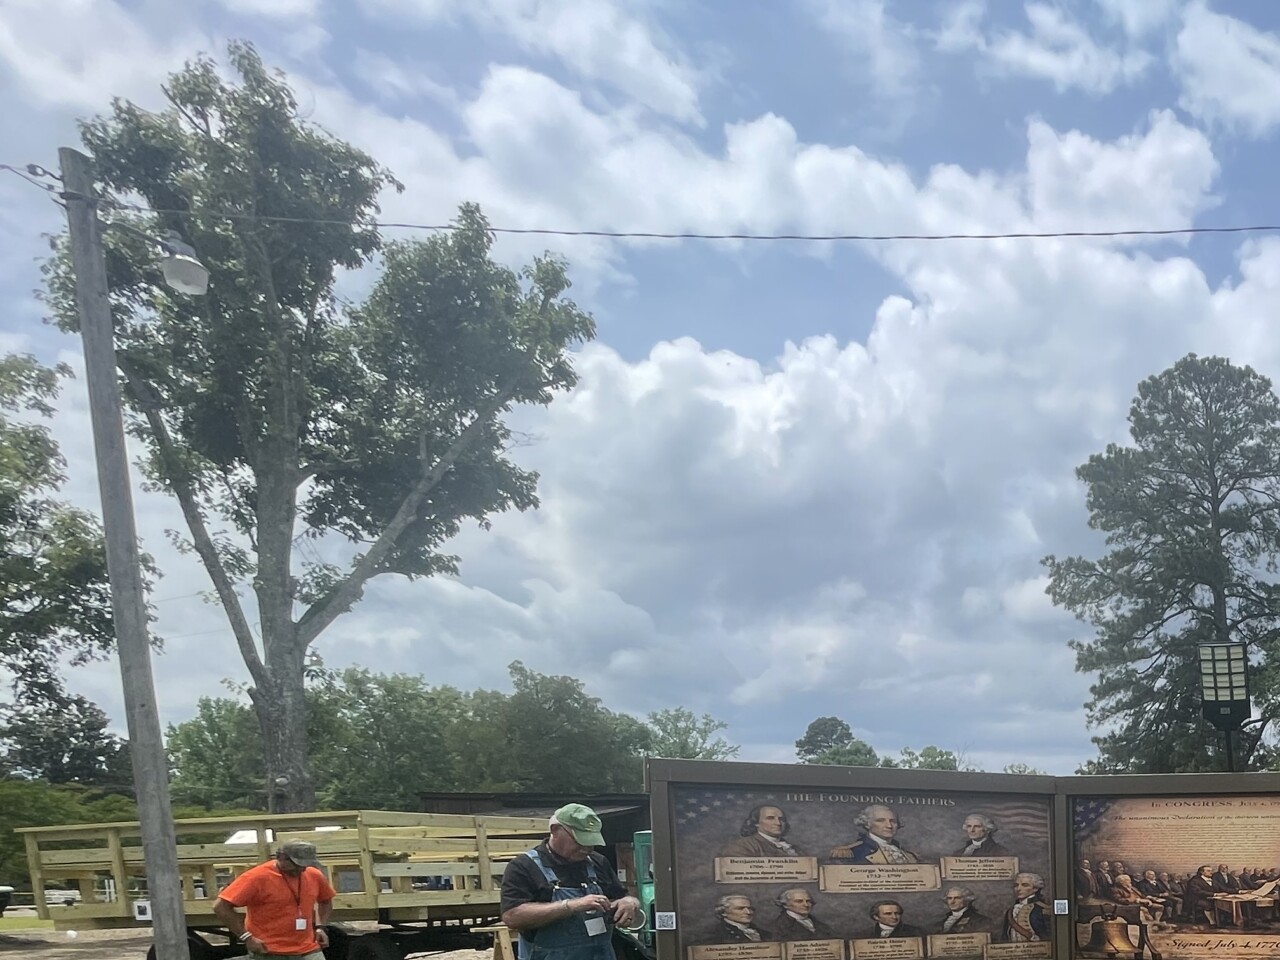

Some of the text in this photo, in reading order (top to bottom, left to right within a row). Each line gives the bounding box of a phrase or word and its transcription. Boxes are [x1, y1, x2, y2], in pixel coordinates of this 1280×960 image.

[786, 793, 956, 807] THE FOUNDING FATHERS
[1167, 939, 1209, 951] Signed
[1209, 939, 1238, 951] July
